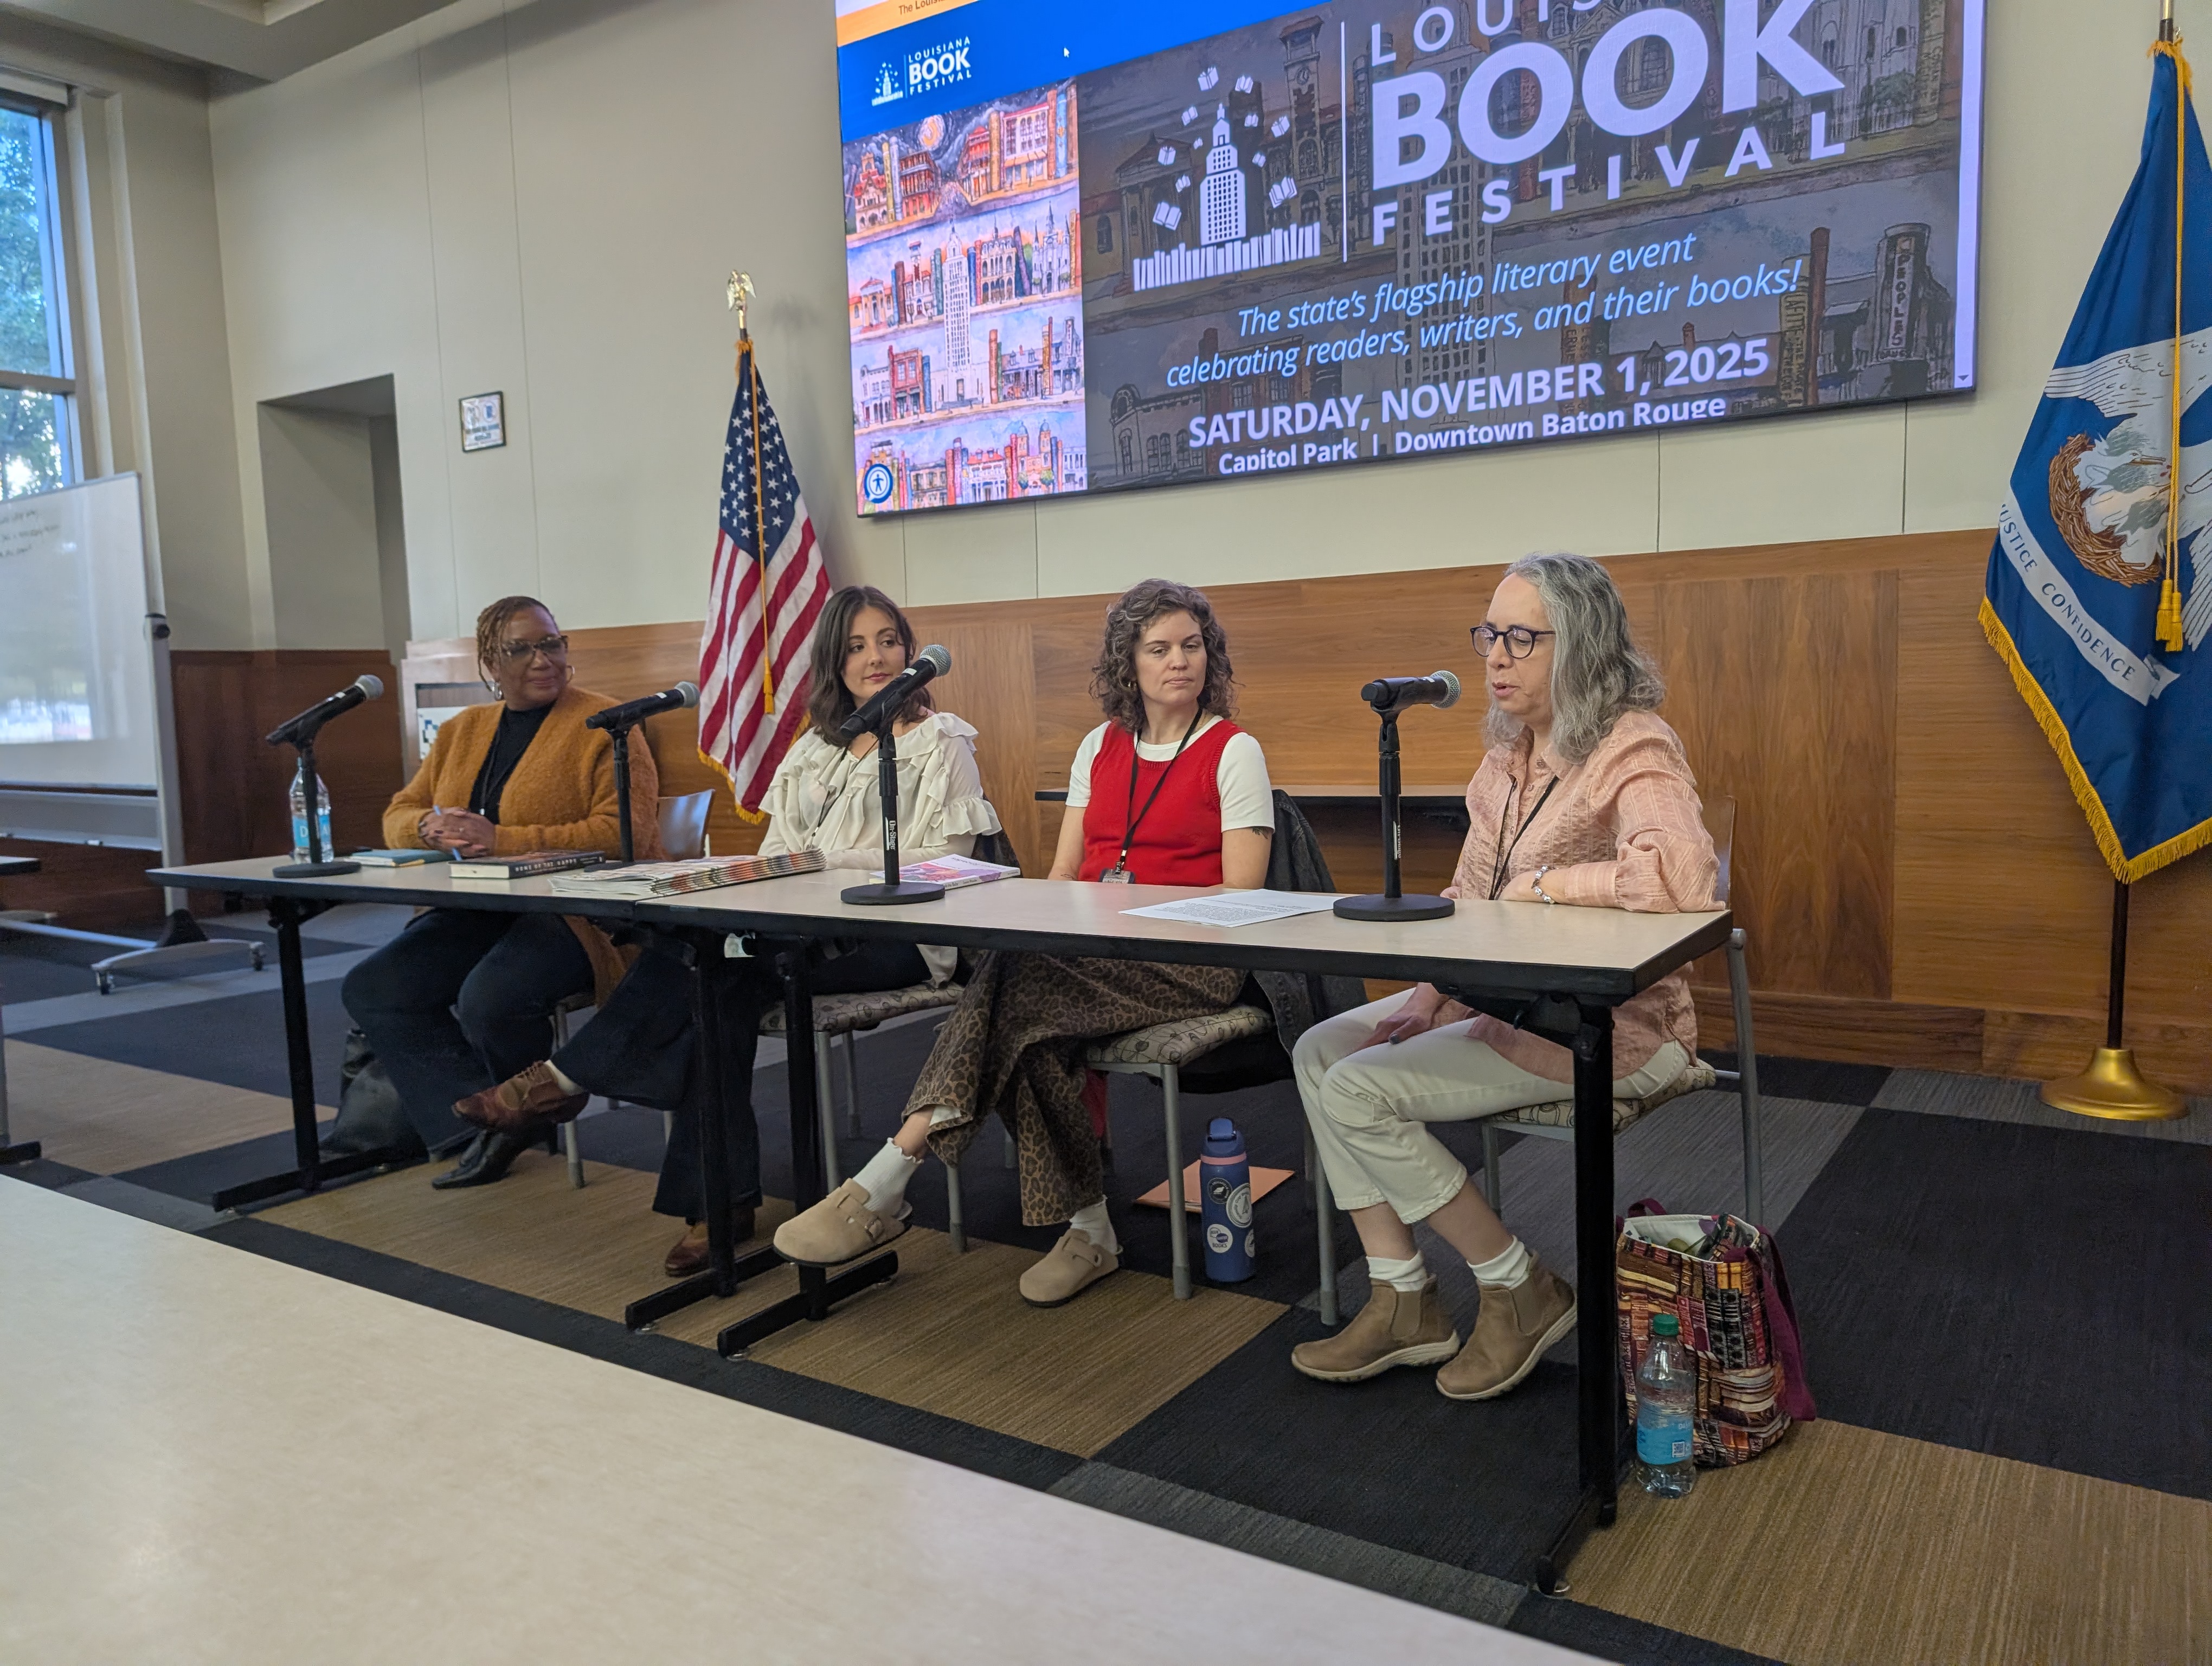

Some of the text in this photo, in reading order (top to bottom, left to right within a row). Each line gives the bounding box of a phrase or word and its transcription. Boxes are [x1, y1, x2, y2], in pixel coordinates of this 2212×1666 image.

[898, 4, 912, 15] The
[908, 36, 970, 63] LOUISIANA
[909, 48, 971, 85] BOOK
[910, 70, 971, 95] FESTIVAL
[1372, 0, 1845, 190] BOOK
[1373, 112, 1845, 246] FESTIVAL
[1167, 259, 1802, 388] celebrating readers, writers, and their books!
[1239, 232, 1696, 337] The state's flagship literary event
[1189, 338, 1769, 448] SATURDAY, NOVEMBER 1, 2025
[1218, 443, 1296, 475] Capitol
[1303, 438, 1358, 465] Park
[1395, 419, 1533, 454] Downtown
[1541, 407, 1625, 437] Baton
[1633, 396, 1726, 426] Rouge
[1999, 504, 2136, 681] USTICE CONFIDENCE
